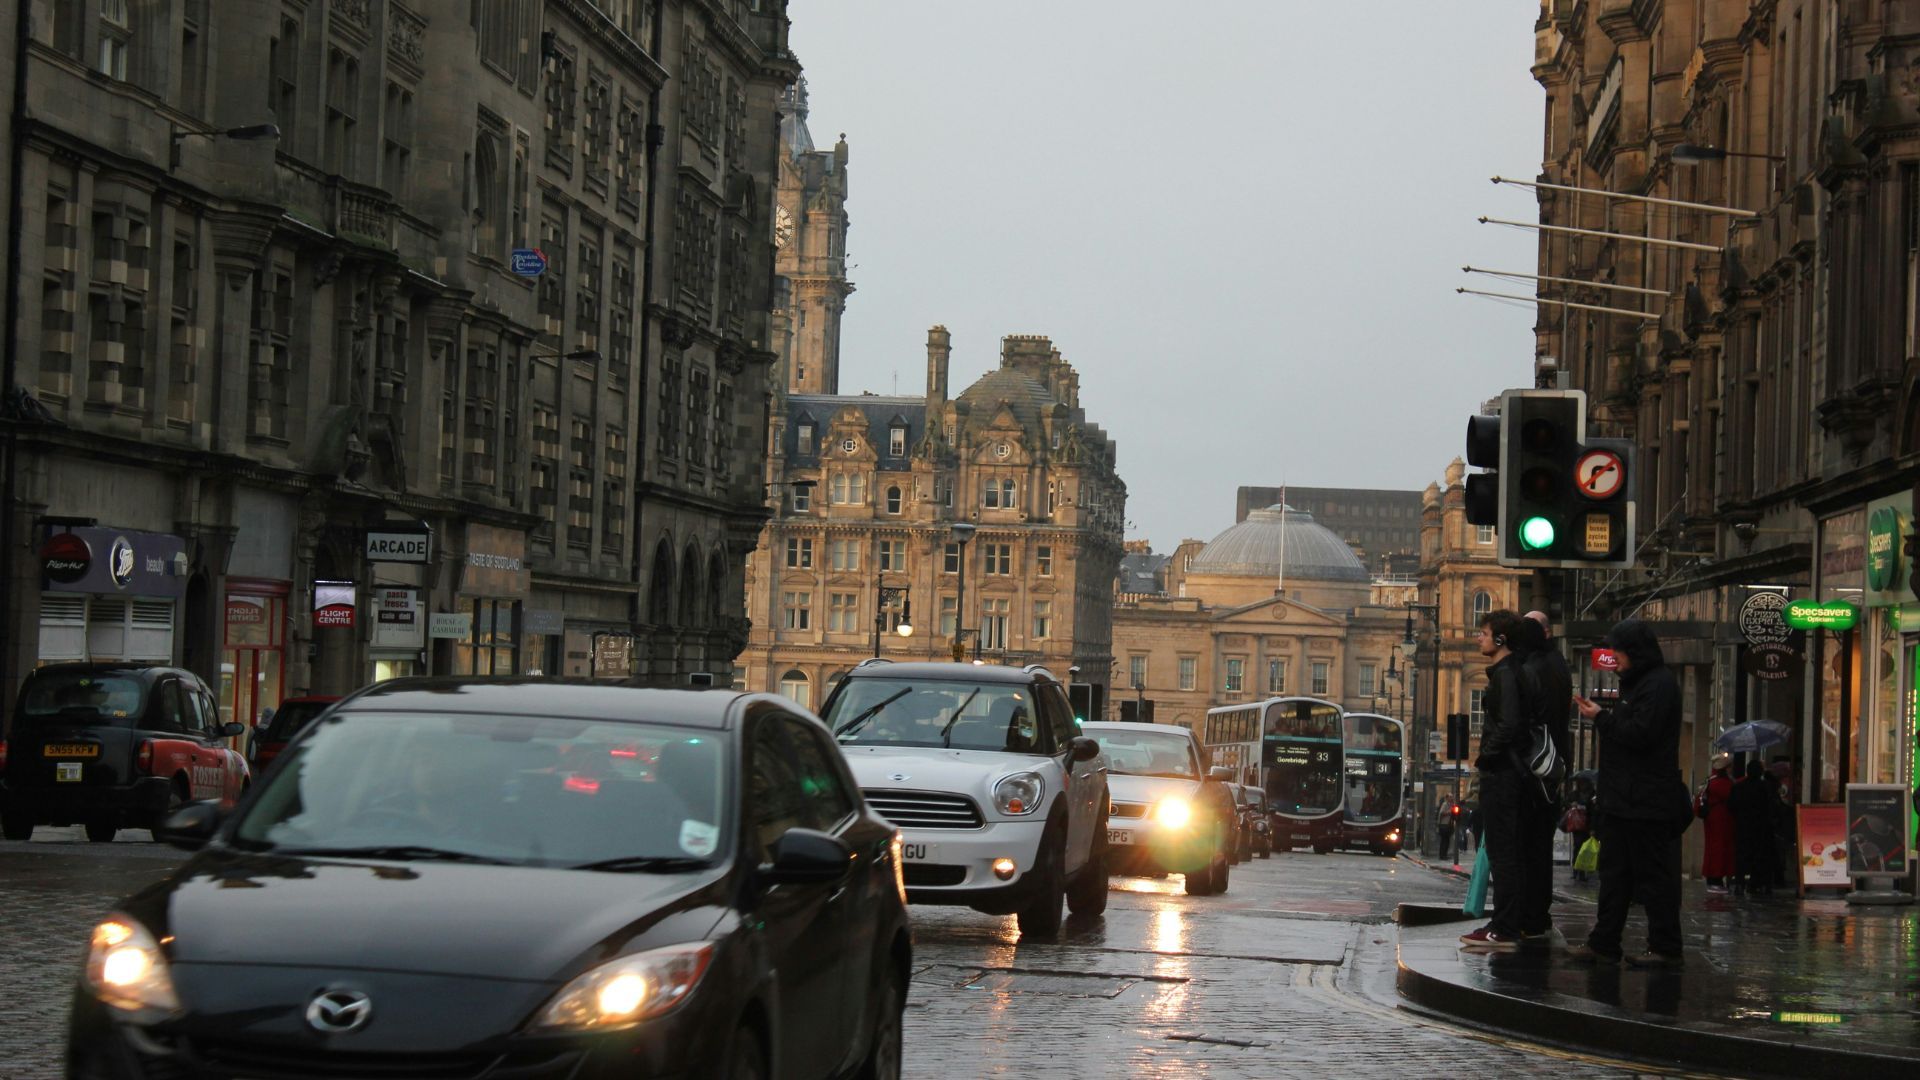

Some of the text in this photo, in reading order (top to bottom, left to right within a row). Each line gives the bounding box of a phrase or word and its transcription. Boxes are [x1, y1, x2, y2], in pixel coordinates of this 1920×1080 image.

[369, 540, 426, 554] ARCADE
[46, 560, 68, 569] Pizza
[146, 555, 164, 576] beauty
[469, 553, 520, 570] TASTE OF SCOTLAND
[386, 591, 408, 600] pasta
[384, 600, 409, 608] fresca
[1754, 611, 1781, 619] PIZZA
[1791, 606, 1852, 617] Specsavers
[318, 616, 351, 624] CENTRE
[436, 616, 456, 625] HOUSE
[432, 626, 465, 635] CASHMERE
[1752, 643, 1794, 656] PATISSERIE
[1756, 670, 1788, 679] VALERIE
[1316, 752, 1329, 762] 33
[1378, 763, 1388, 773] 31
